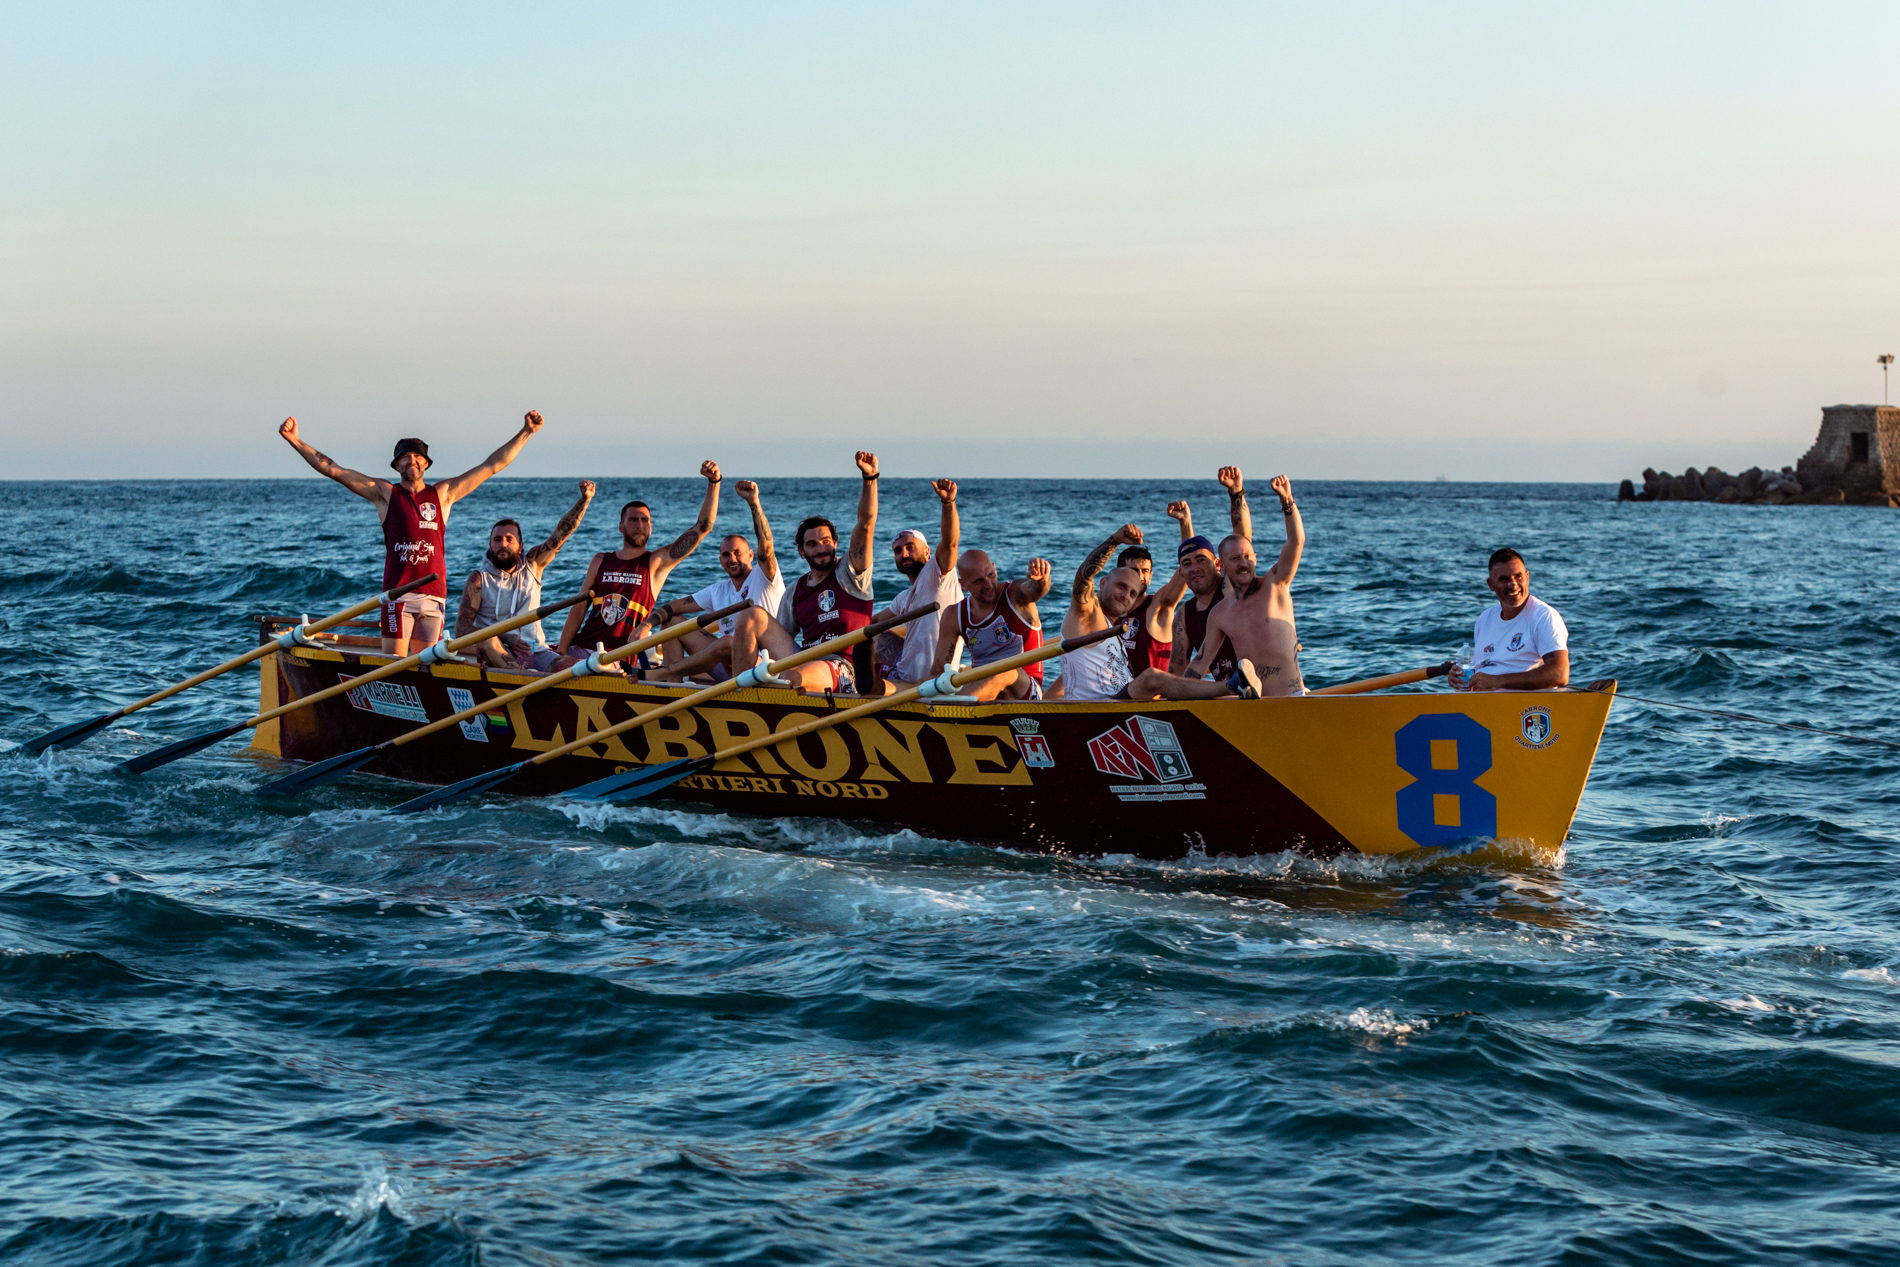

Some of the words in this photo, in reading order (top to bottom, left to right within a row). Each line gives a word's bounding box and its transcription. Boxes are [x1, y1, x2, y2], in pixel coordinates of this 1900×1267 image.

[602, 576, 642, 586] LABRONE
[388, 614, 398, 633] NORD
[362, 681, 423, 709] MARTELLI
[1519, 705, 1552, 717] LABRONE
[463, 724, 483, 735] GARE
[490, 687, 1034, 786] LABRONE
[1514, 735, 1545, 750] QUARTIERI
[1544, 733, 1560, 748] NORD
[790, 780, 889, 800] NORD
[1162, 783, 1184, 791] NORD
[1394, 711, 1497, 854] 8
